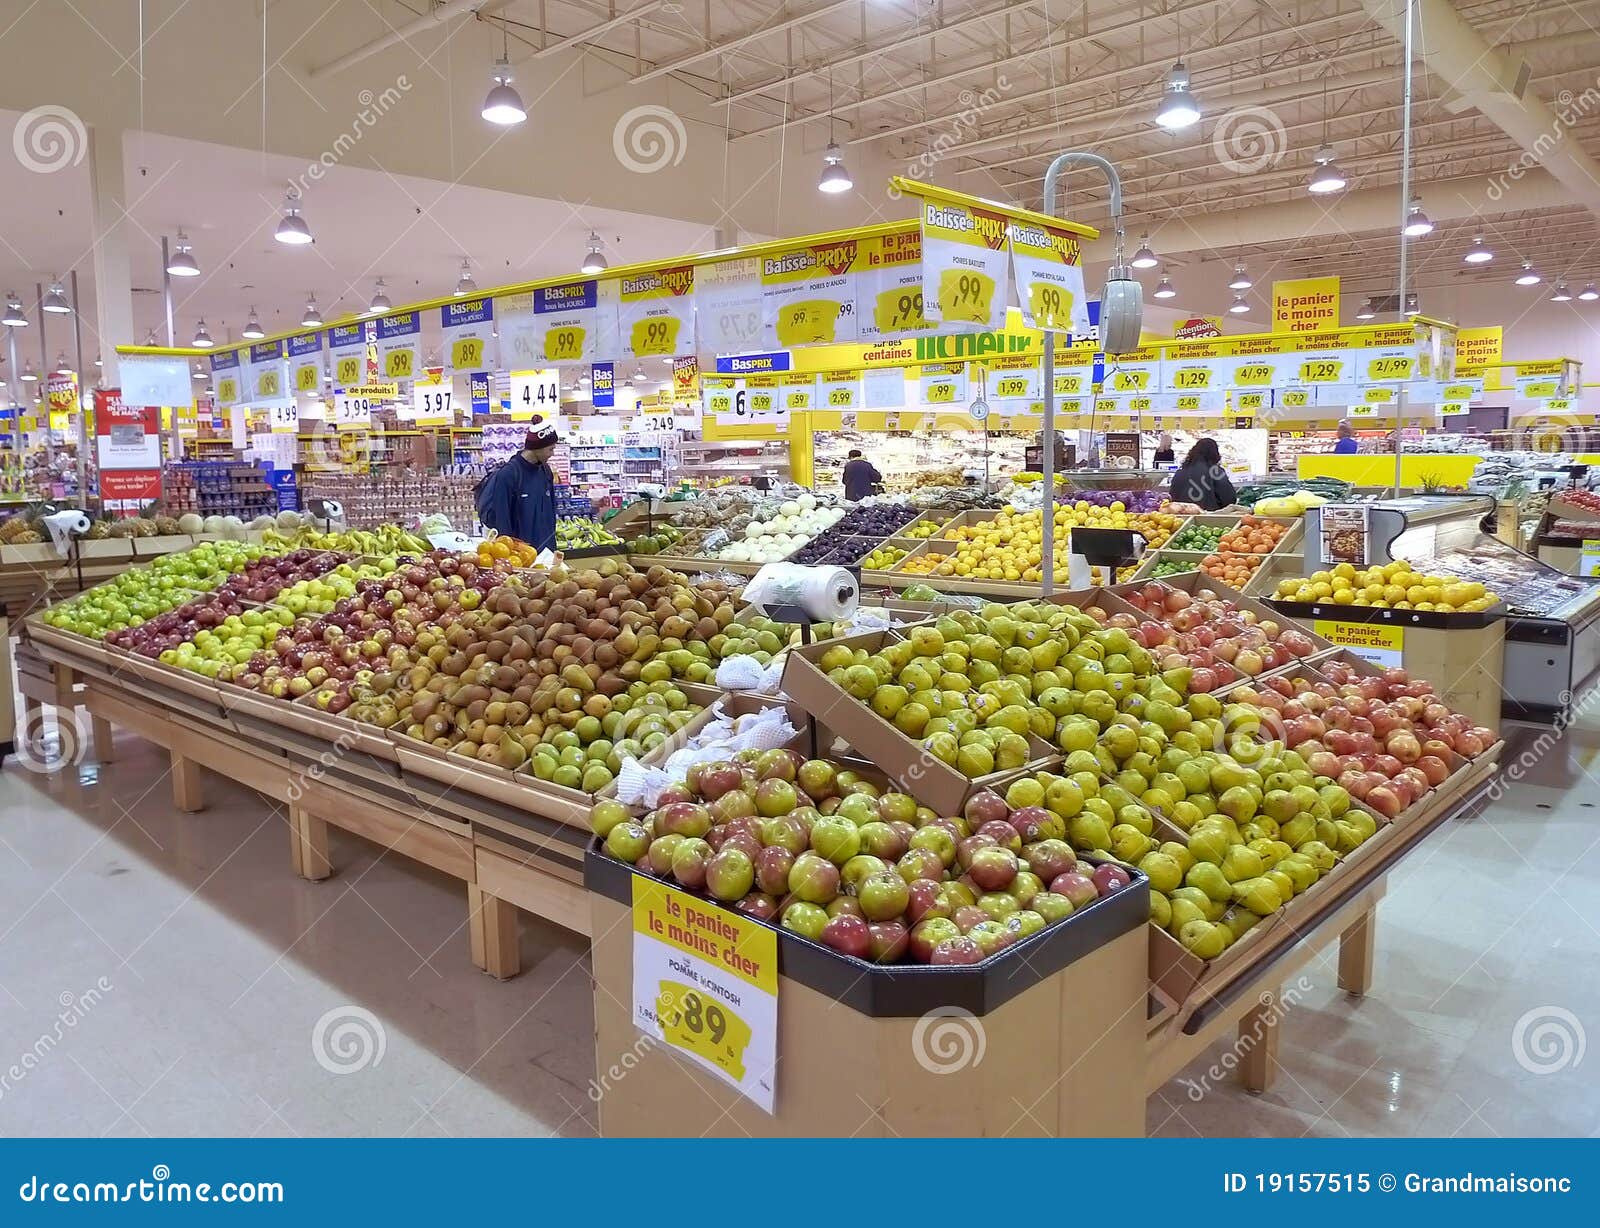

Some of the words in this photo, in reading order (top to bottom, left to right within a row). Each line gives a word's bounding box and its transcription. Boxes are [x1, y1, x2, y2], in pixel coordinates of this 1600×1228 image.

[926, 204, 967, 232] Baisse
[974, 215, 1005, 240] PRIX!
[882, 235, 894, 248] le
[897, 232, 921, 249] pan
[1012, 224, 1046, 248] Baisse
[763, 256, 807, 275] Baisse
[815, 245, 855, 268] PRIX!
[869, 251, 880, 265] le
[883, 247, 921, 263] moins
[622, 278, 655, 294] Baisse
[662, 271, 693, 289] PRIX!
[1277, 296, 1289, 308] le
[1290, 292, 1335, 309] panier
[1276, 309, 1289, 321] le
[1291, 307, 1334, 319] moins
[1290, 320, 1319, 332] cher
[1384, 329, 1412, 338] panier
[1305, 342, 1329, 350] moins
[1374, 338, 1400, 346] moins
[1456, 338, 1465, 347] le
[1466, 337, 1499, 348] panier
[863, 346, 912, 361] centaines
[1456, 347, 1465, 356] le
[1466, 346, 1498, 355] moins
[731, 358, 773, 370] BasPRIX
[1466, 355, 1487, 364] cher
[593, 369, 613, 380] Bas
[472, 380, 488, 391] Bas
[593, 379, 613, 390] PRIX
[522, 382, 558, 407] 4,44
[343, 398, 369, 419] 3,99
[424, 391, 452, 414] 3,97
[1133, 399, 1149, 408] 129
[1335, 624, 1345, 634] le
[1347, 626, 1381, 637] panier
[1324, 633, 1334, 642] le
[1336, 635, 1367, 645] moins
[1370, 636, 1393, 647] cher
[665, 893, 681, 918] le
[685, 906, 740, 944] panier
[648, 910, 664, 935] le
[667, 927, 718, 959] moins
[722, 945, 760, 979] cher
[668, 958, 699, 982] POMME
